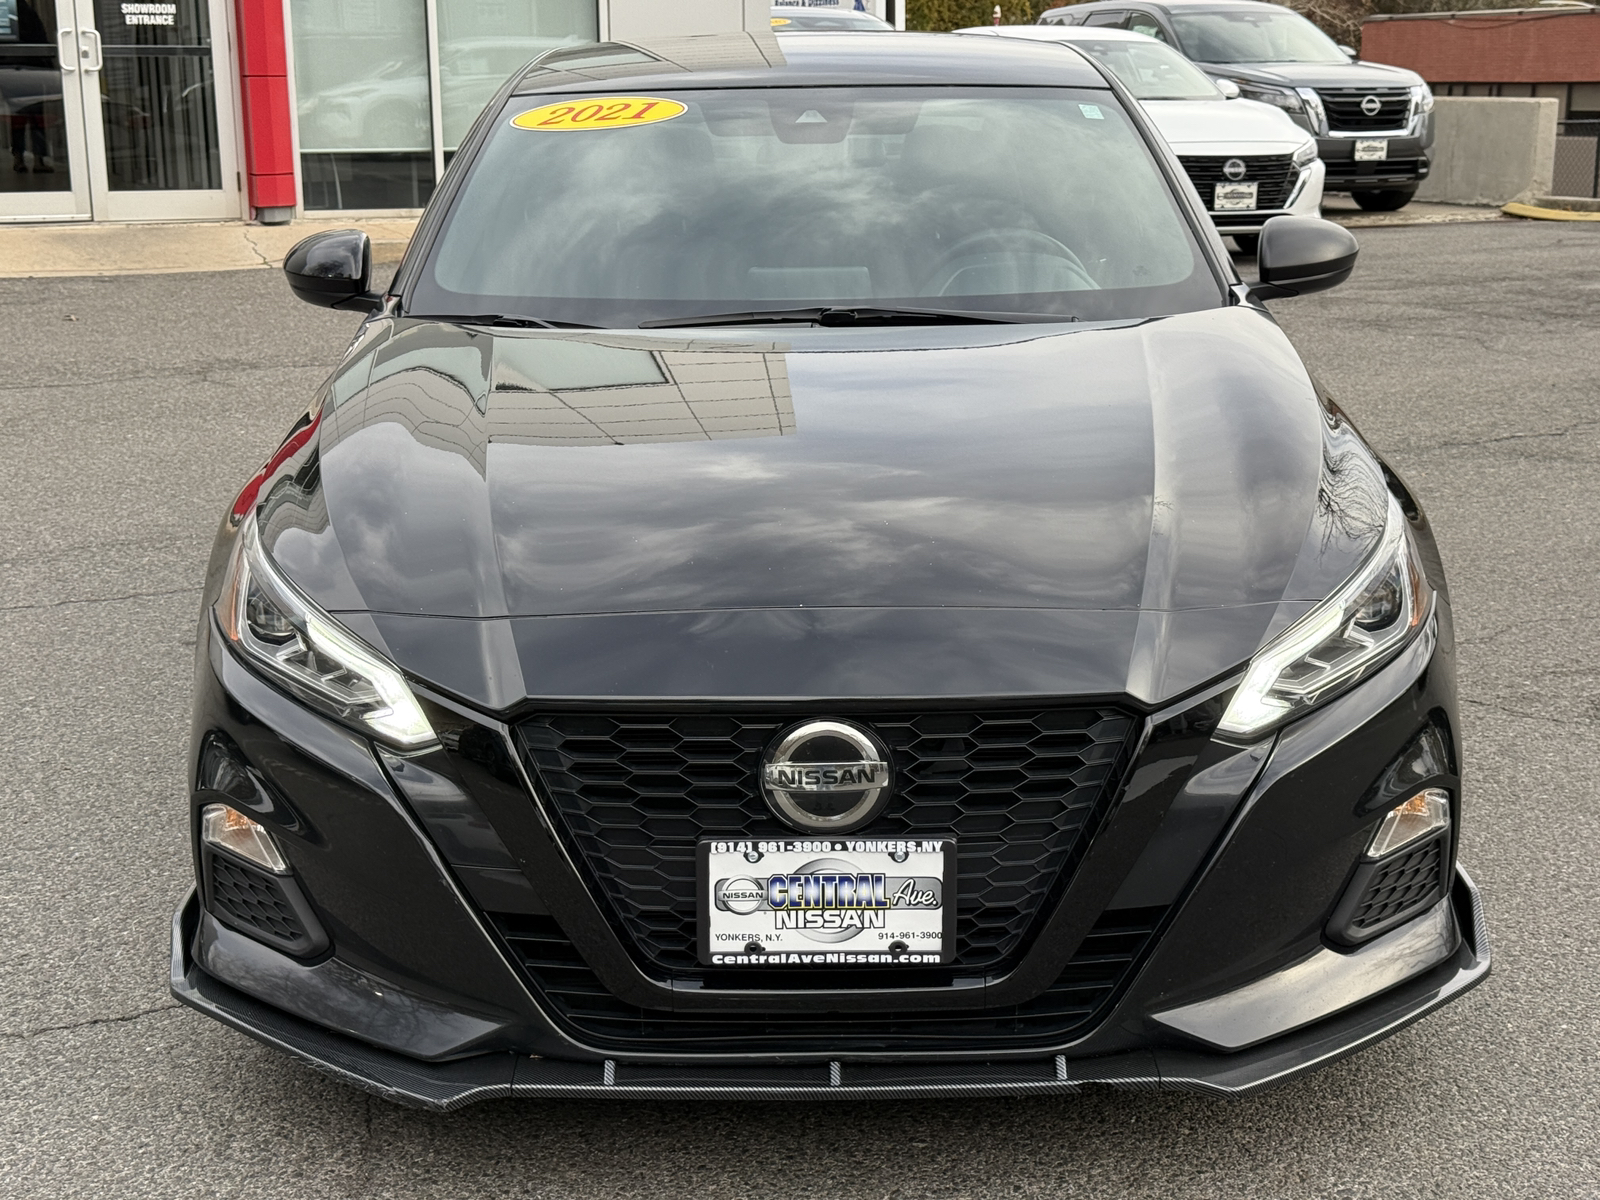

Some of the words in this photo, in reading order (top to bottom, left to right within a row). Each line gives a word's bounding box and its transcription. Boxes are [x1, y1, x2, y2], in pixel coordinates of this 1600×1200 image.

[121, 3, 176, 14] SHOWROOM
[125, 14, 174, 25] ENTRANCE
[537, 102, 660, 126] 2021
[778, 769, 875, 785] NISSAN
[758, 841, 831, 853] 961-3900
[768, 874, 891, 910] CENTRAL
[892, 878, 938, 906] Ave.
[775, 909, 885, 929] NISSAN
[715, 933, 763, 942] YONKERS,
[878, 931, 942, 940] 914-961-3900
[712, 953, 940, 964] CentralAveNissan.com
